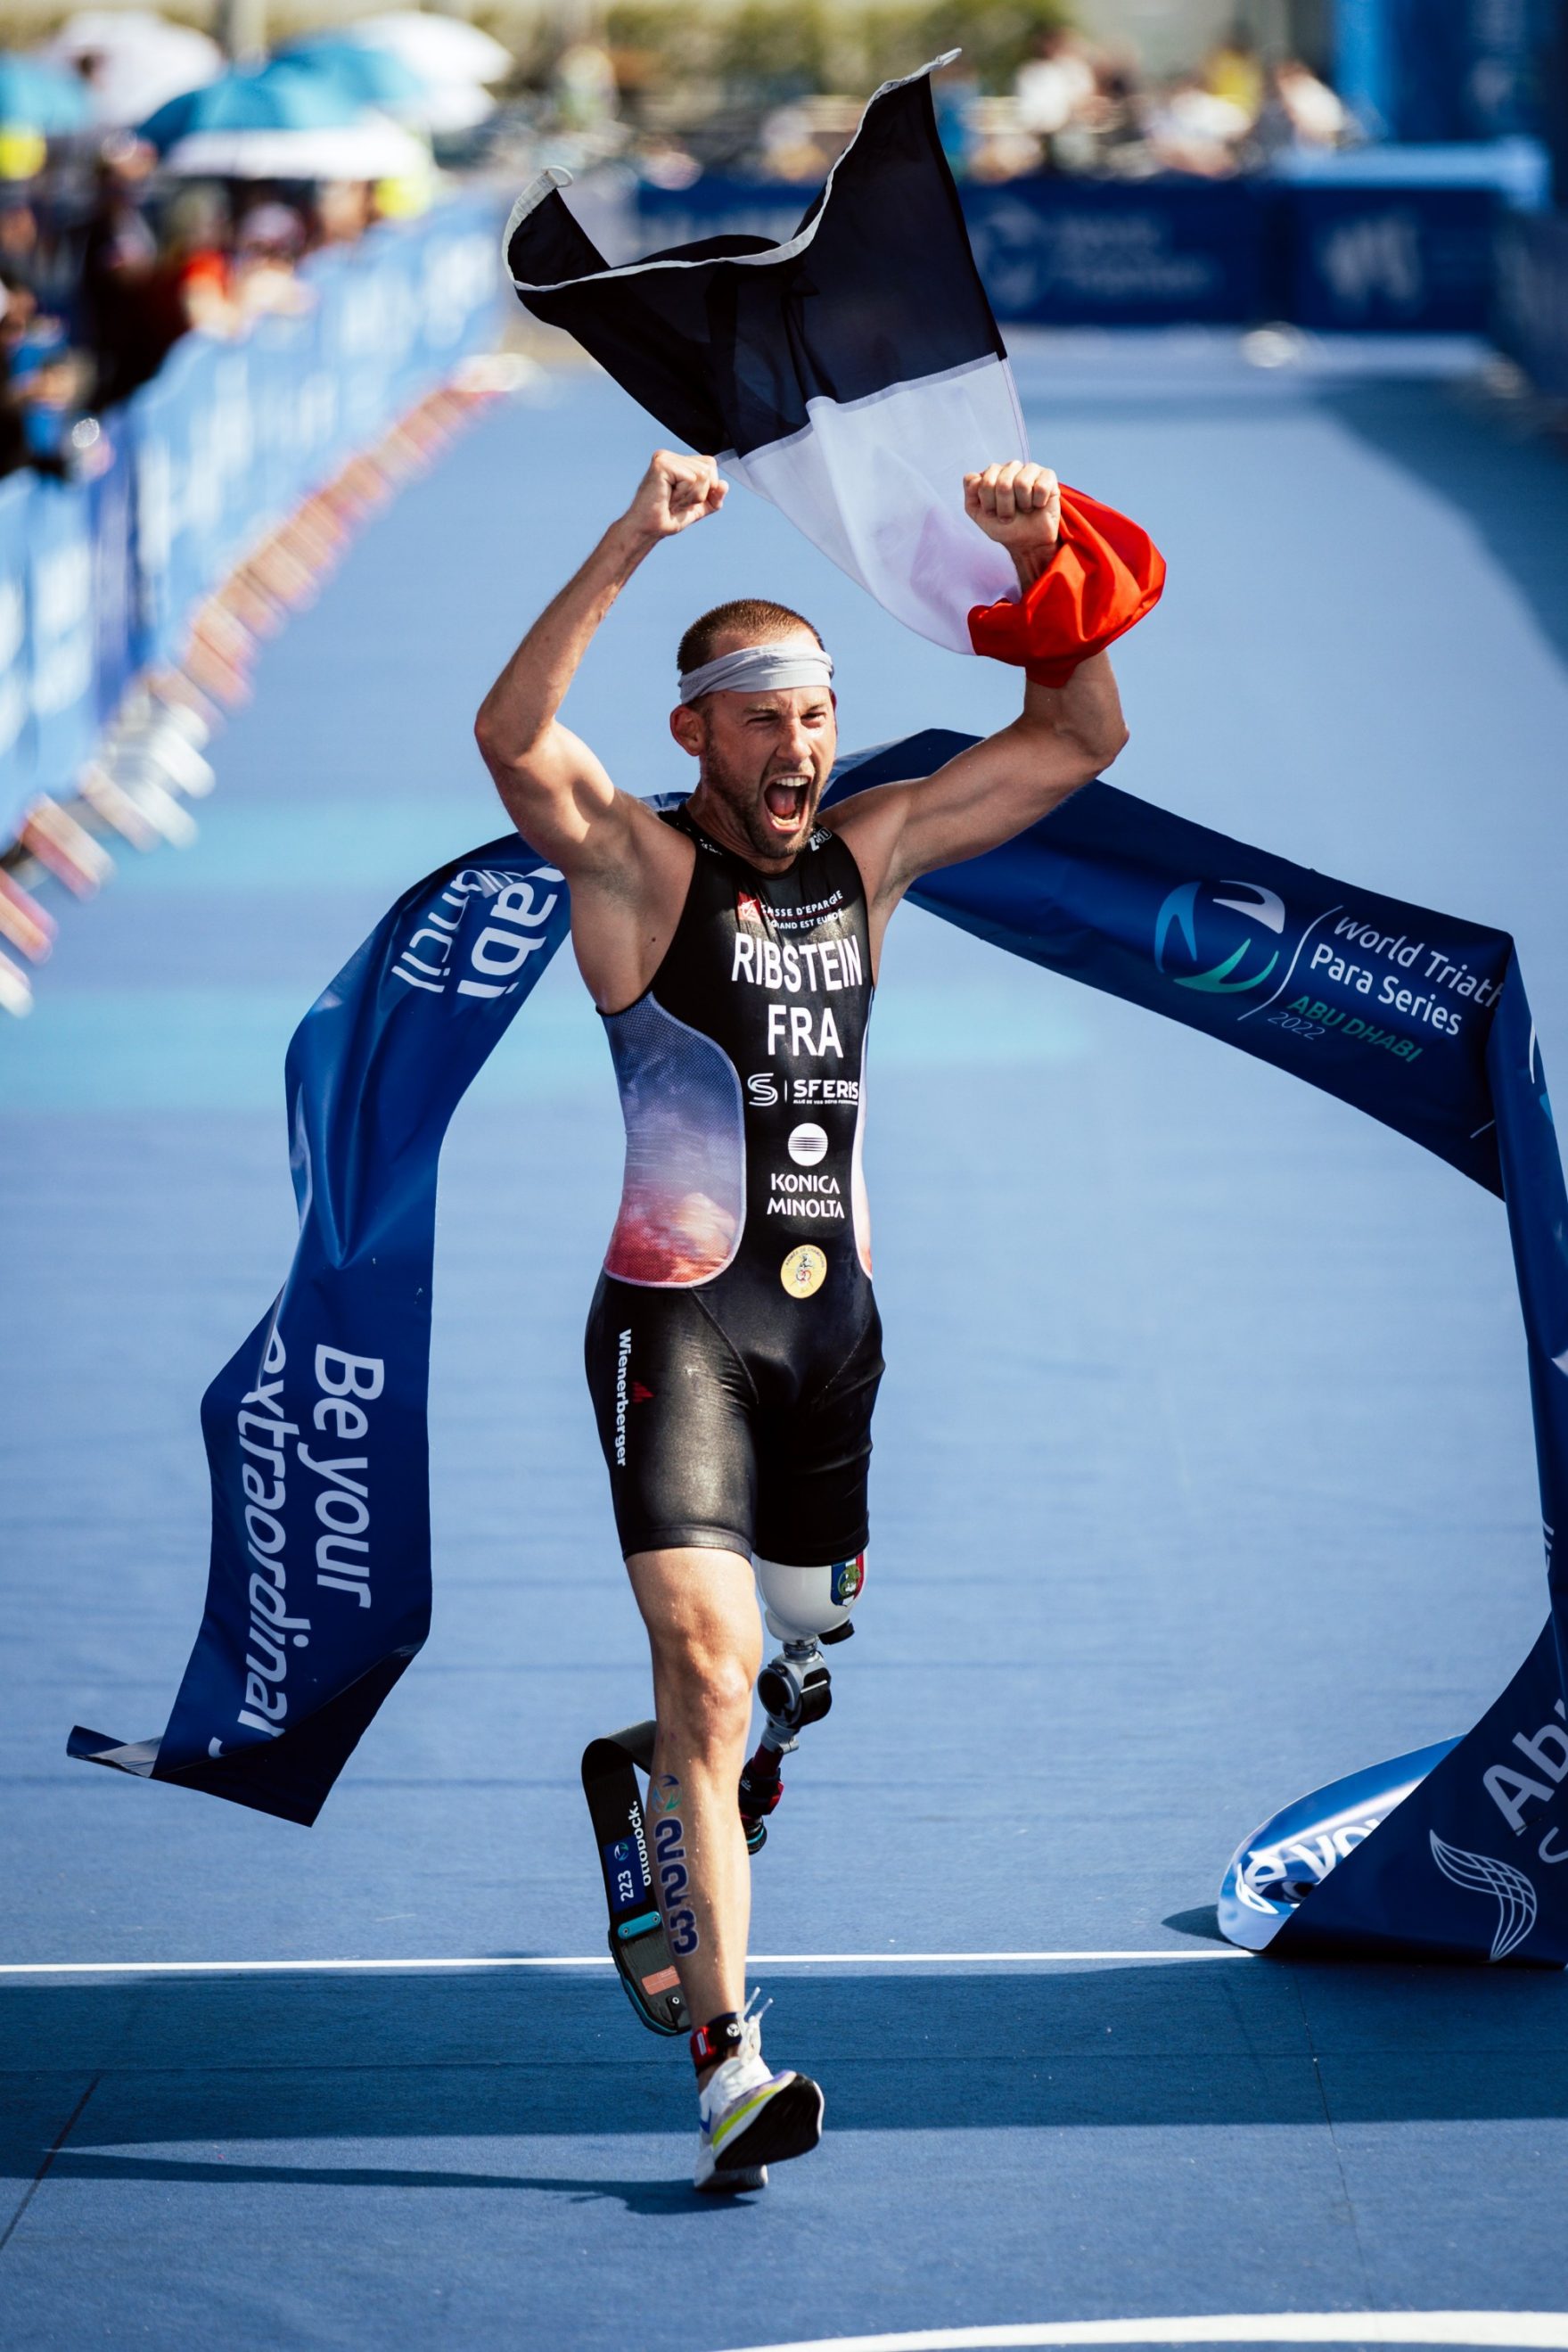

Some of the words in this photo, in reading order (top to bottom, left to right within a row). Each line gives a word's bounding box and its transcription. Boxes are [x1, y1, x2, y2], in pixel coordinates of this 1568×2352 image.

[800, 918, 814, 928] EST
[1334, 917, 1424, 967] World
[732, 932, 863, 992] RIBSTEIN
[1309, 943, 1373, 994] Para
[1377, 975, 1463, 1035] Series
[768, 1004, 844, 1058] FRA
[1267, 1012, 1326, 1040] 2022
[1286, 995, 1346, 1026] ABU
[1341, 1018, 1424, 1063] DHABI
[767, 1197, 845, 1219] MINOLTA
[771, 1173, 840, 1194] KONICA
[313, 1344, 384, 1440] Be
[615, 1328, 632, 1467] Wienerberger
[296, 1443, 371, 1608] your
[1483, 1698, 1568, 1837] Ab
[618, 1869, 635, 1903] 223
[653, 1816, 699, 1957] 223
